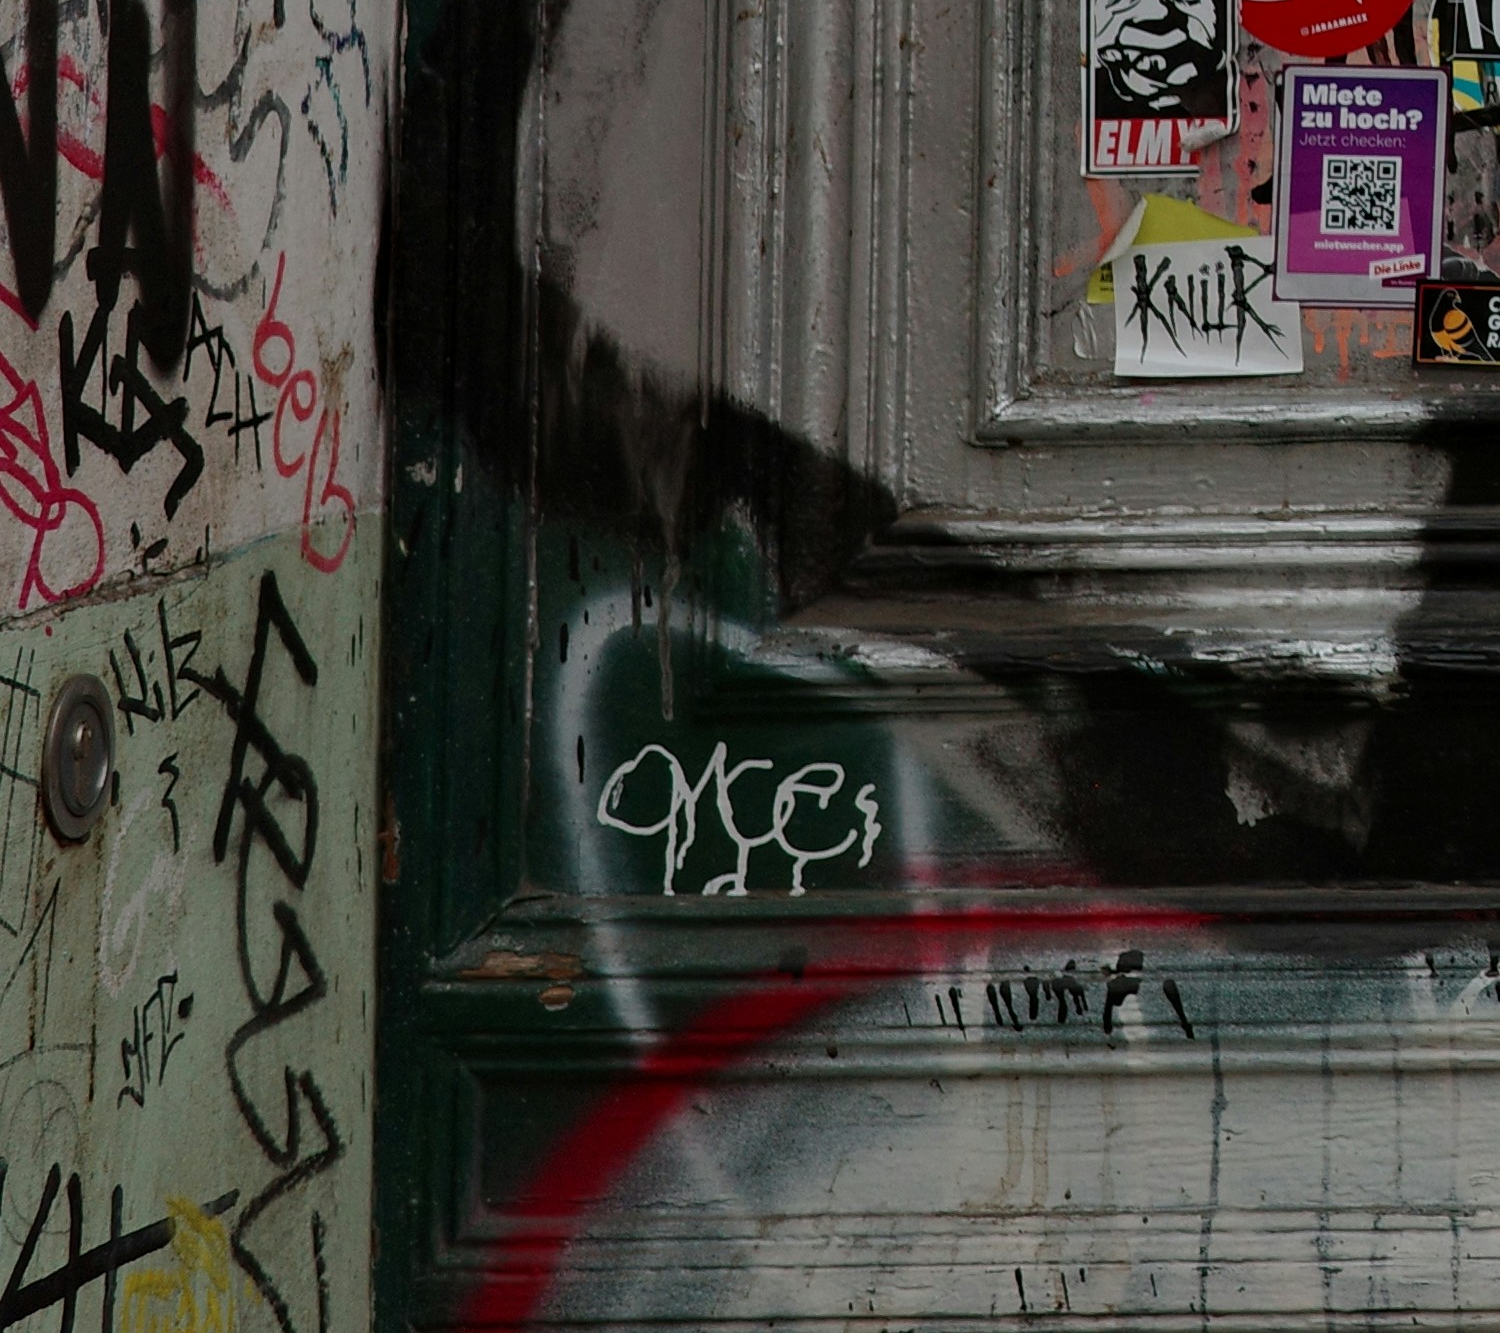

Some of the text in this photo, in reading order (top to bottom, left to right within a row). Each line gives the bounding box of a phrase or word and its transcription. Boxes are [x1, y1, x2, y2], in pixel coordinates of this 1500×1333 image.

[1302, 83, 1383, 108] Miete
[1301, 107, 1424, 131] zu hoch?
[1300, 133, 1406, 150] Jetzt checken:
